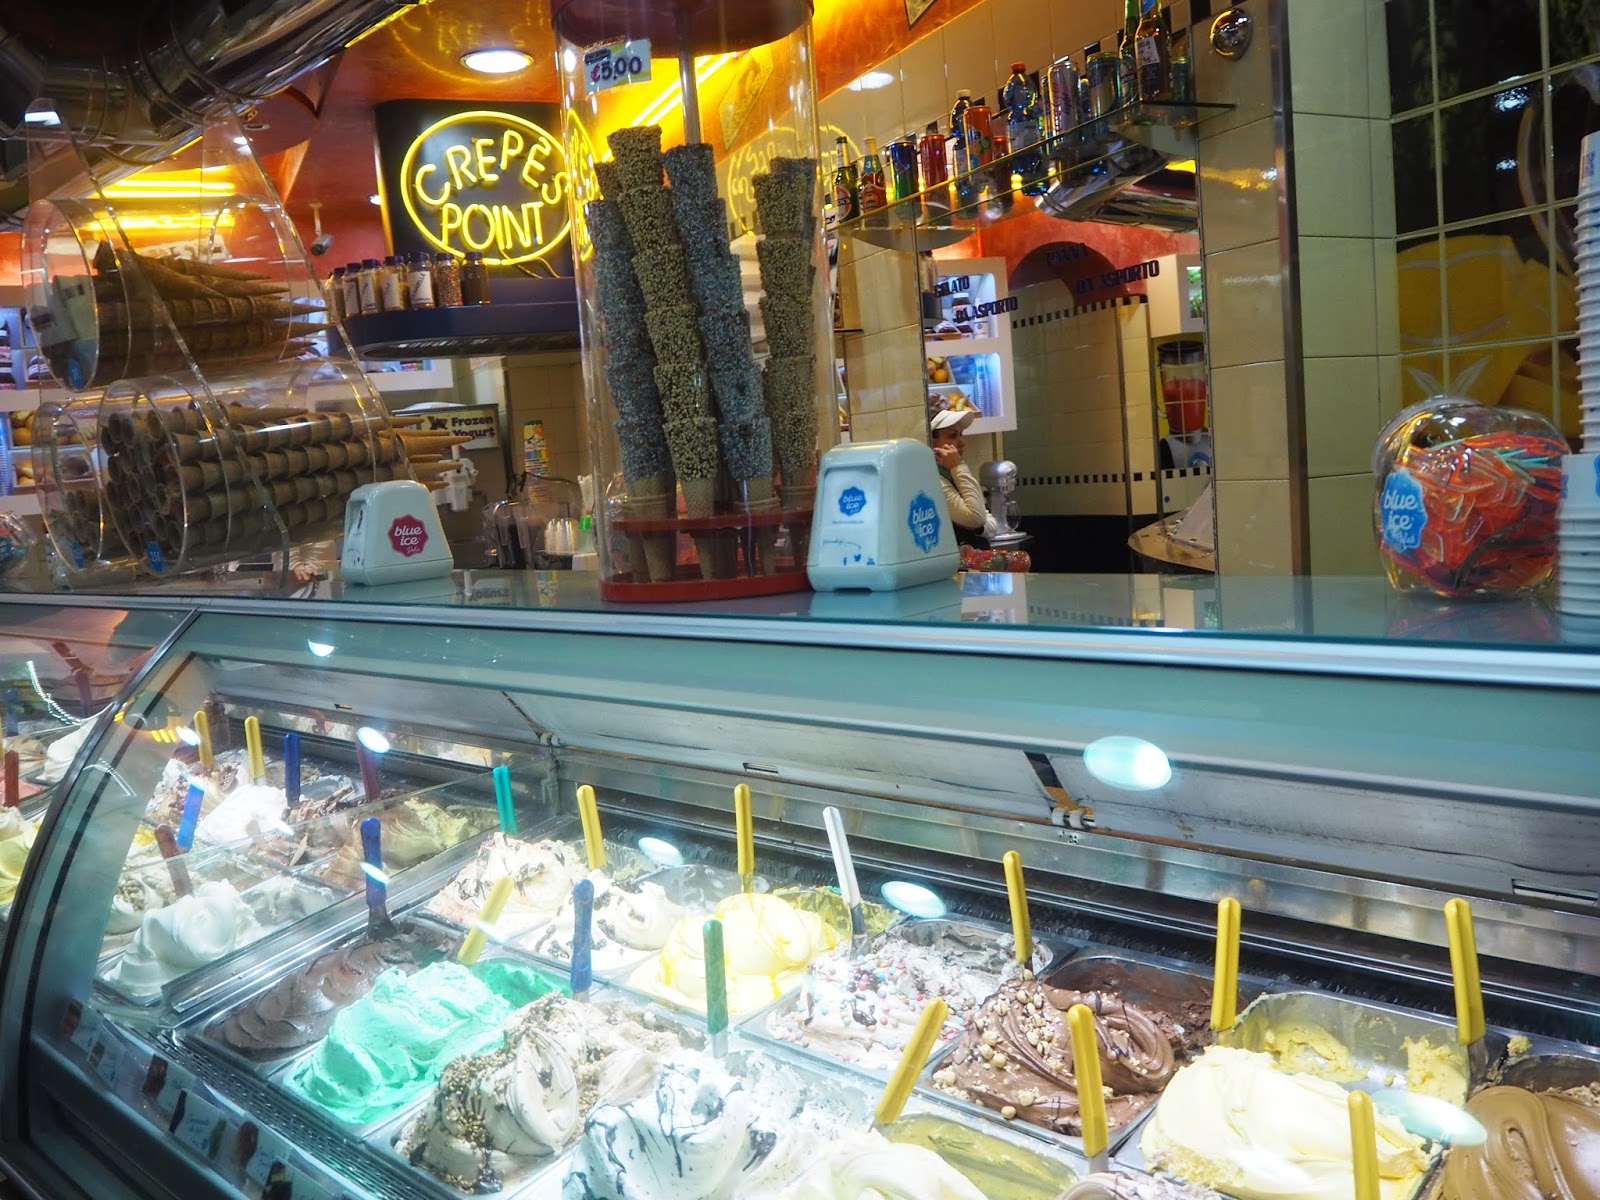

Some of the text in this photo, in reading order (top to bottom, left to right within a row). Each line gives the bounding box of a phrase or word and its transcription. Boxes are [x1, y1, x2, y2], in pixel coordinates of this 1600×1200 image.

[415, 129, 572, 205] CREPES
[441, 201, 544, 250] POINT
[1099, 259, 1160, 289] ASPORTO
[934, 276, 970, 298] GELATO
[972, 296, 1018, 320] ASPORTO
[451, 416, 493, 427] Frozen
[843, 493, 863, 503] blue
[1383, 489, 1418, 511] blue
[912, 507, 935, 525] blue
[1388, 510, 1412, 530] ice
[394, 525, 422, 537] blue
[919, 523, 934, 537] ice
[400, 536, 420, 546] ice
